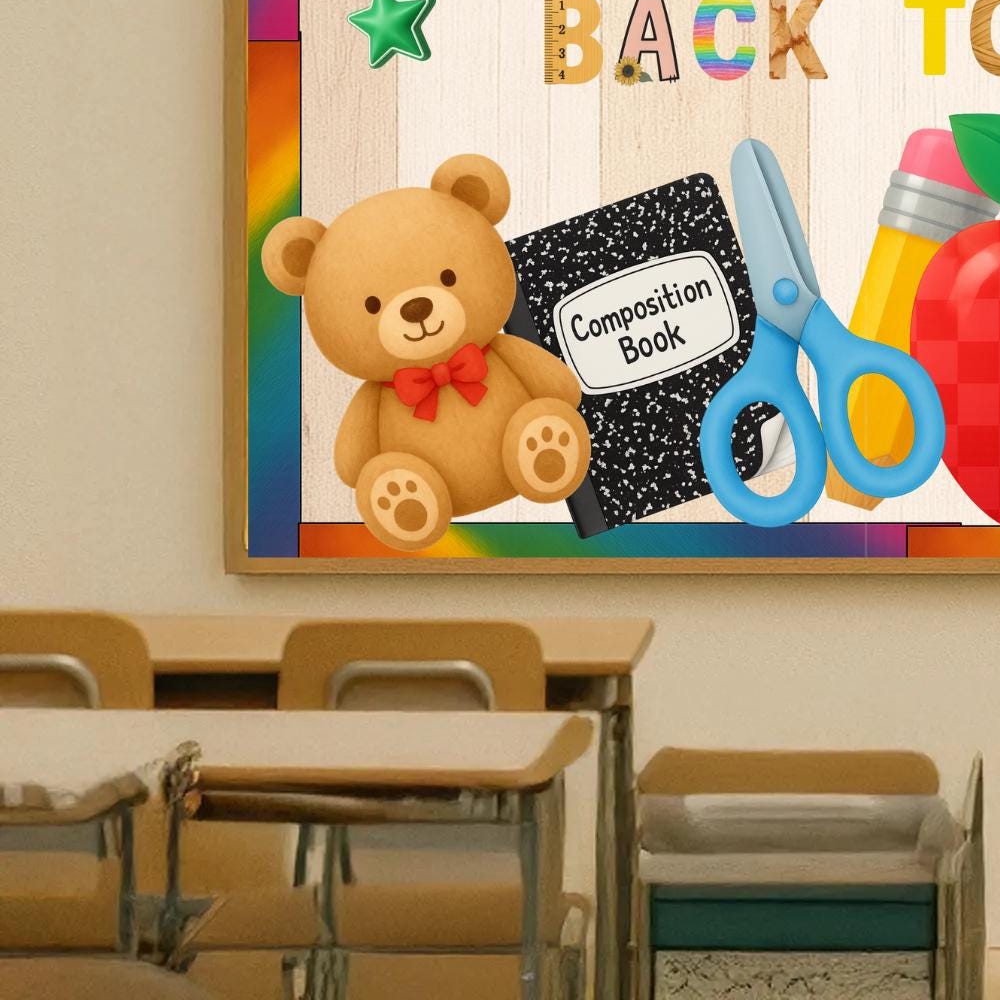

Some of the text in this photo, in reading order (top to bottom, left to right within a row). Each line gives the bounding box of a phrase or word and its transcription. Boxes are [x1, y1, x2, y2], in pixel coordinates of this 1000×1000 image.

[558, 0, 566, 10] 1
[558, 24, 566, 35] 2
[558, 47, 566, 59] 3
[558, 70, 566, 80] 4
[570, 279, 713, 342] Composition
[618, 320, 686, 364] Book
